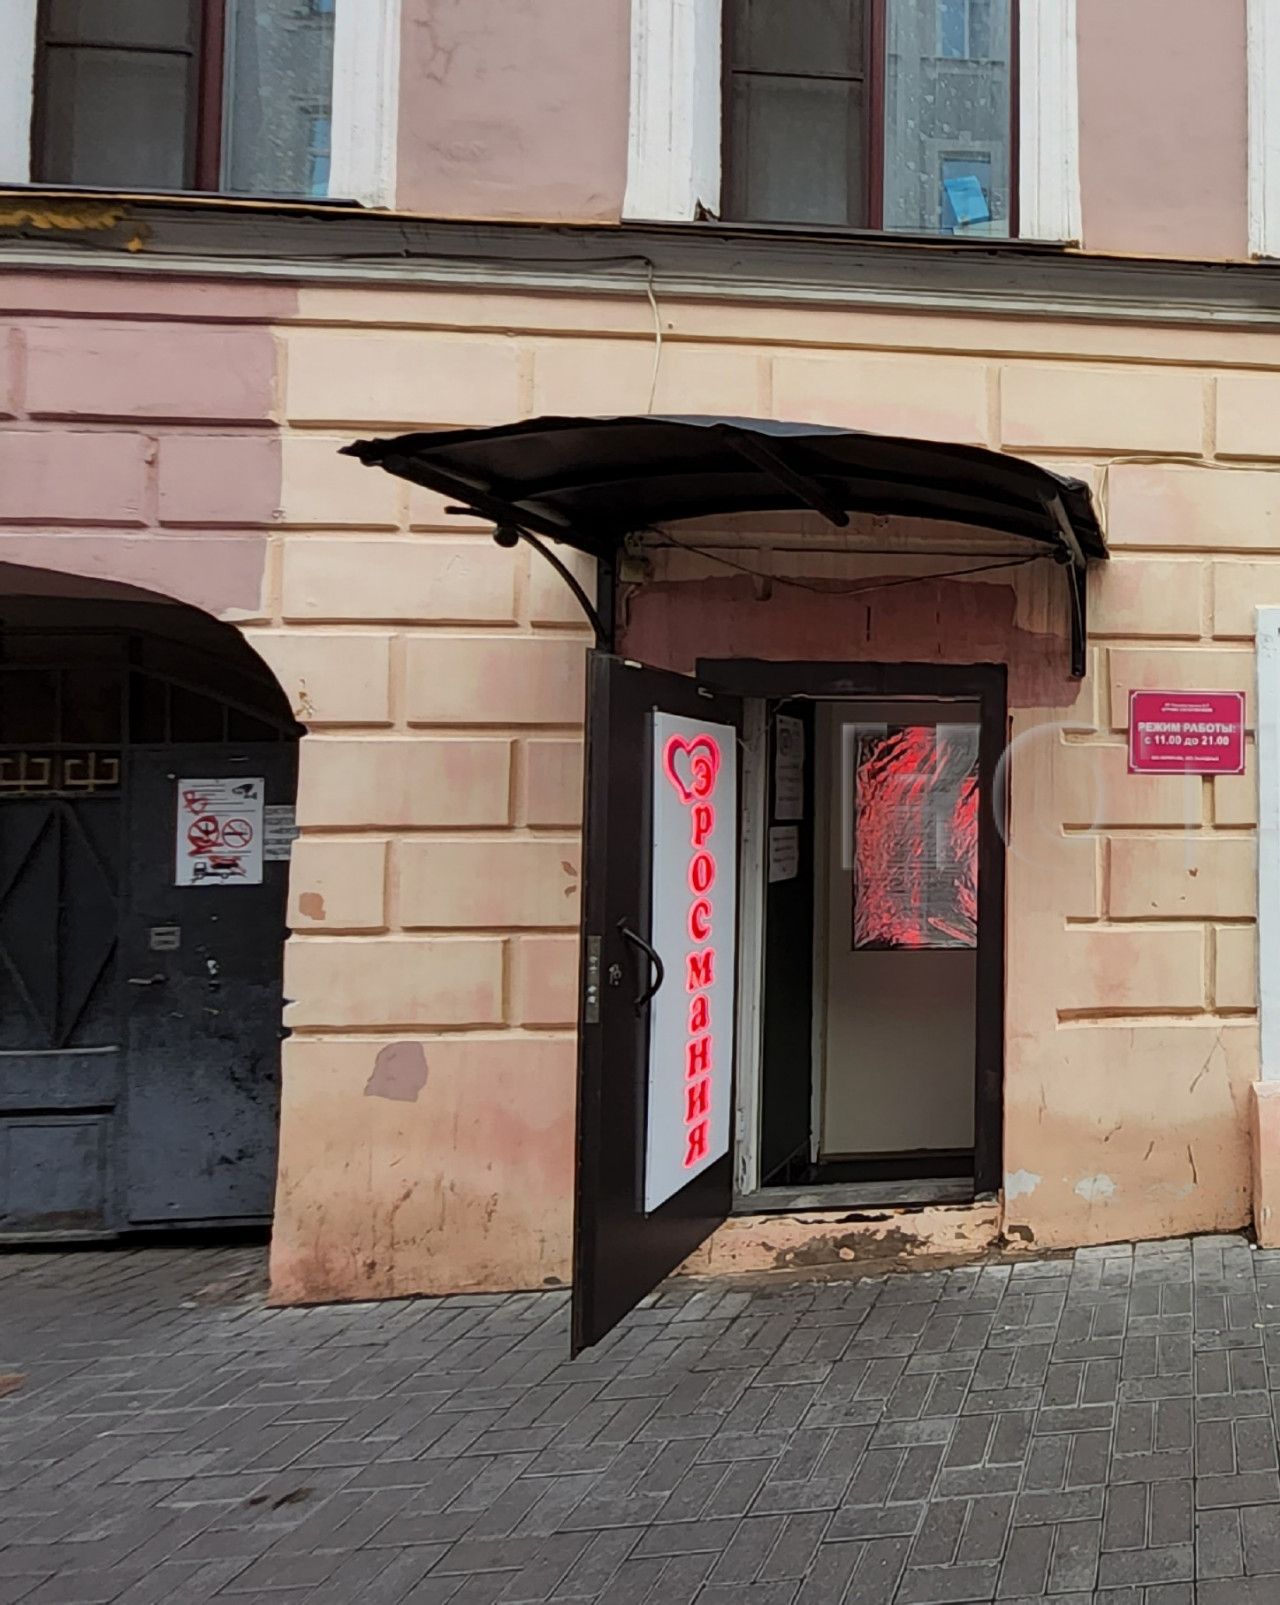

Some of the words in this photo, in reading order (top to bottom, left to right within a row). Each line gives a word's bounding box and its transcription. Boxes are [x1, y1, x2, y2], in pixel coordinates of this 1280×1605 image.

[1138, 722, 1181, 733] РЕЖИМ
[1154, 735, 1182, 745] 11.00
[1183, 737, 1199, 746] до
[1201, 735, 1230, 746] 21.00
